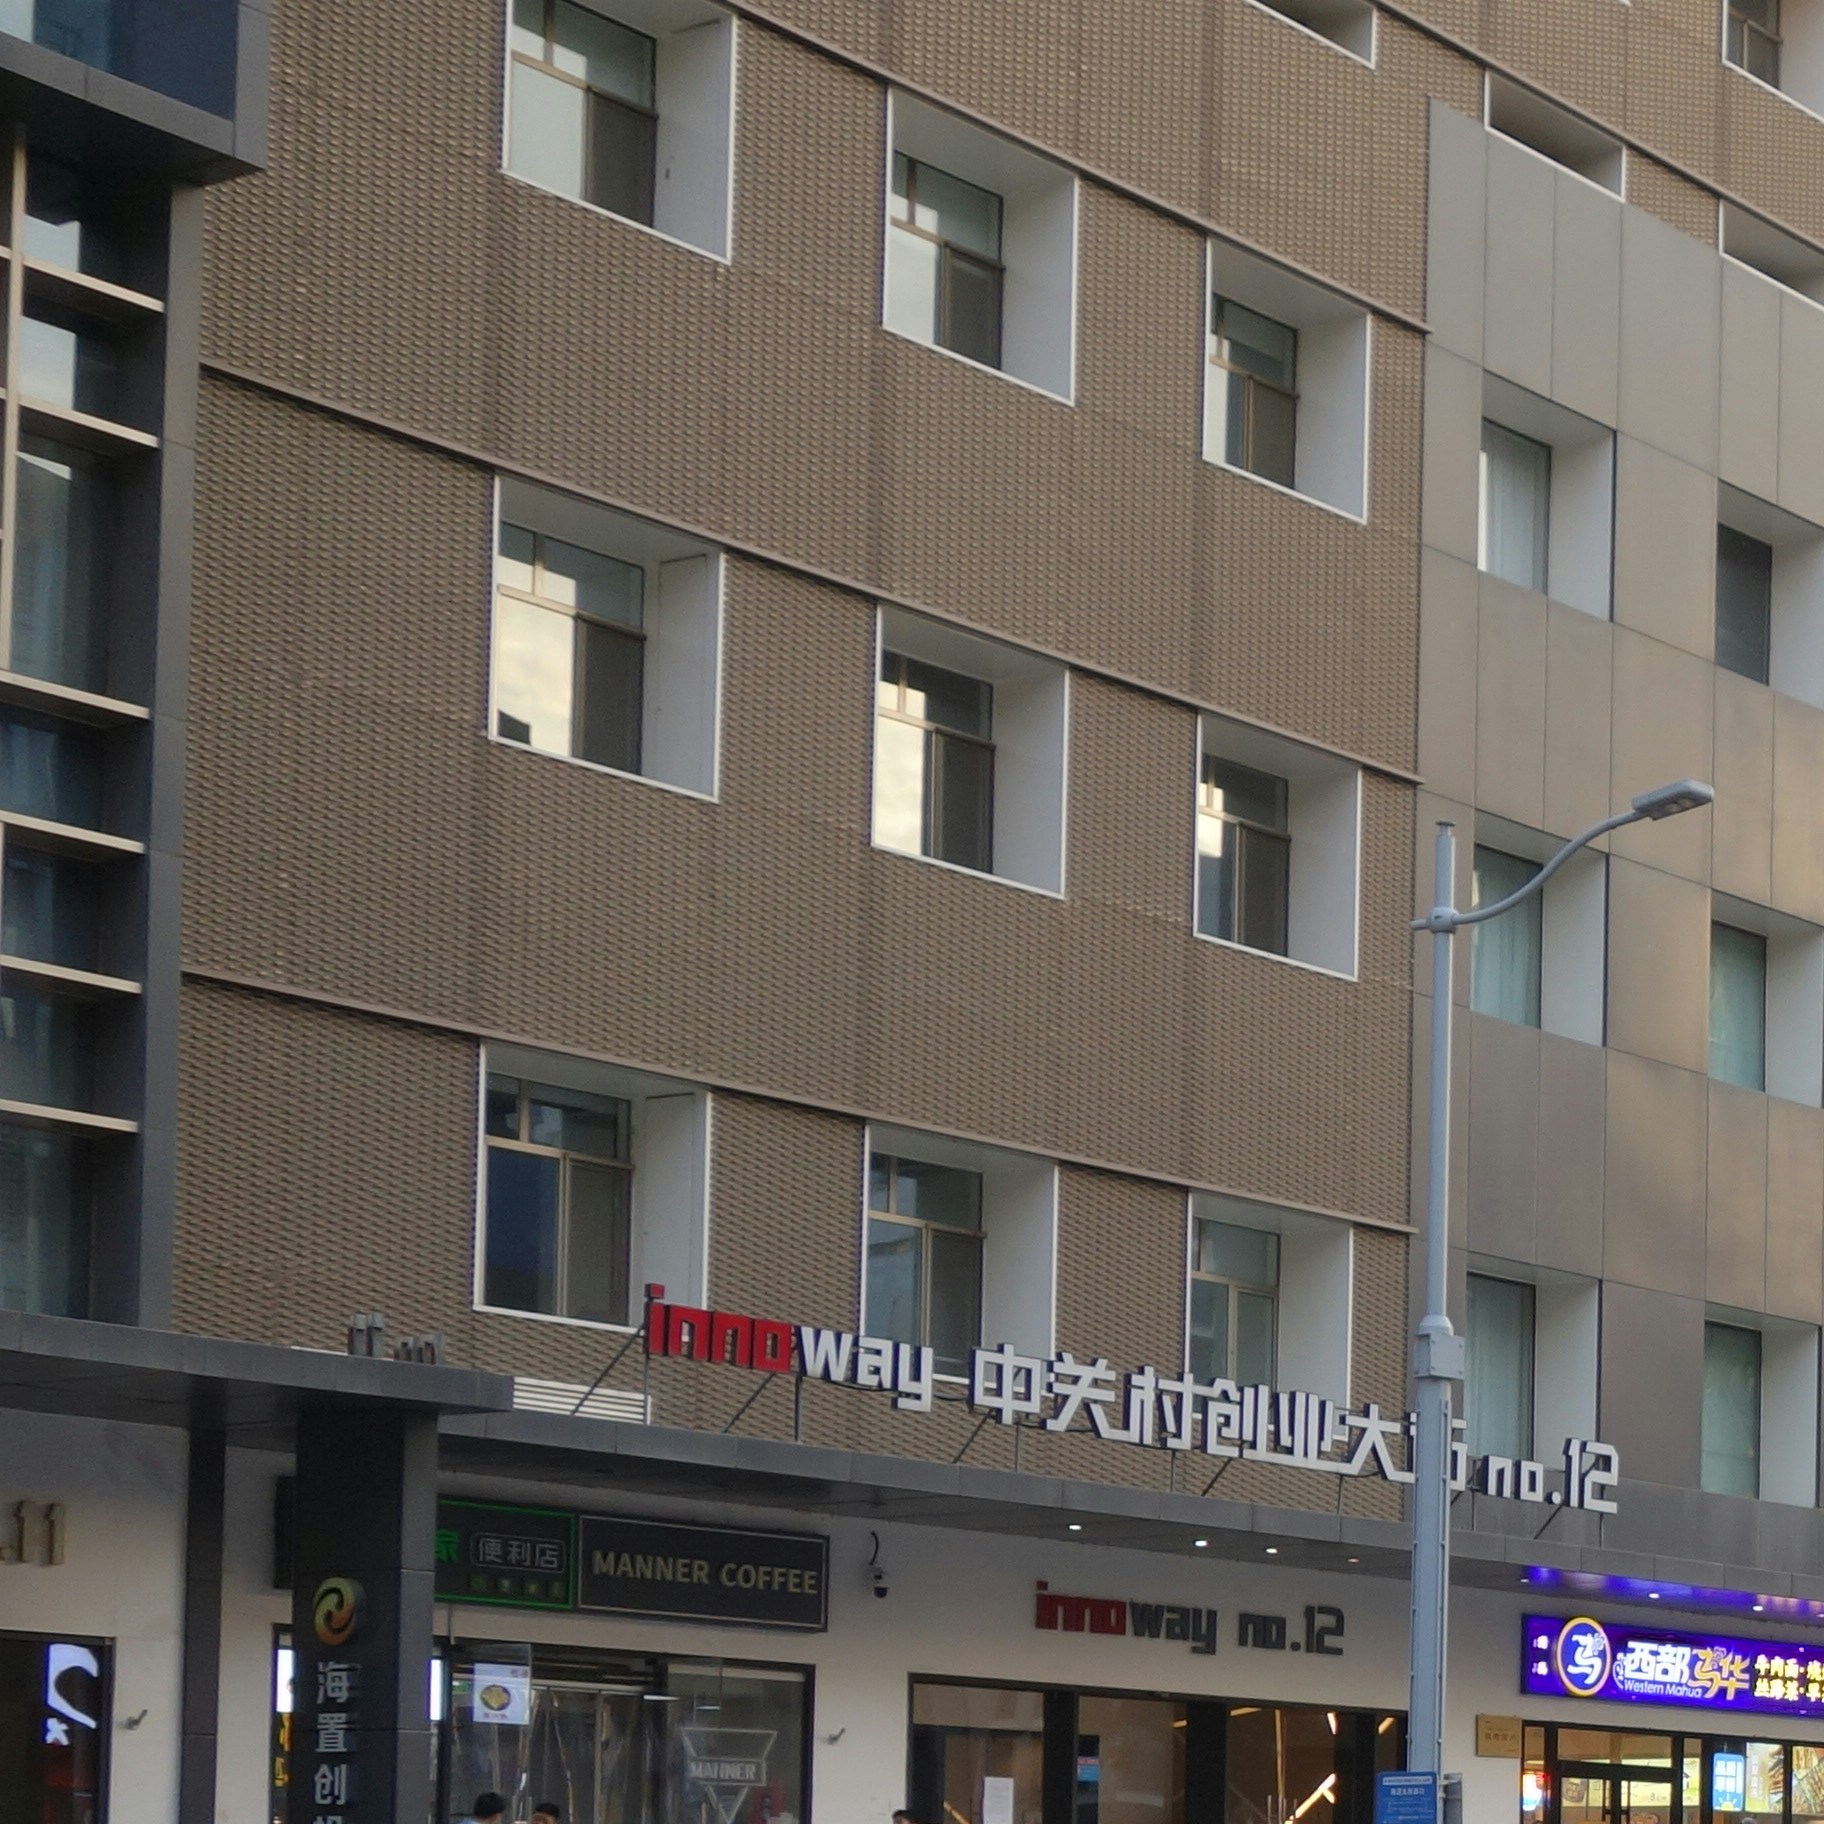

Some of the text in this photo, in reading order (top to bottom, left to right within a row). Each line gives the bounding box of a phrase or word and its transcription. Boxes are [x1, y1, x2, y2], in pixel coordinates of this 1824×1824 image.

[646, 1283, 933, 1412] innoway
[1486, 1437, 1619, 1513] no.12
[478, 1537, 560, 1569] 便利店
[591, 1550, 818, 1595] MANNER COFFEE
[1035, 1579, 1345, 1655] innoway no.12
[1624, 1678, 1702, 1698] Western Mahua
